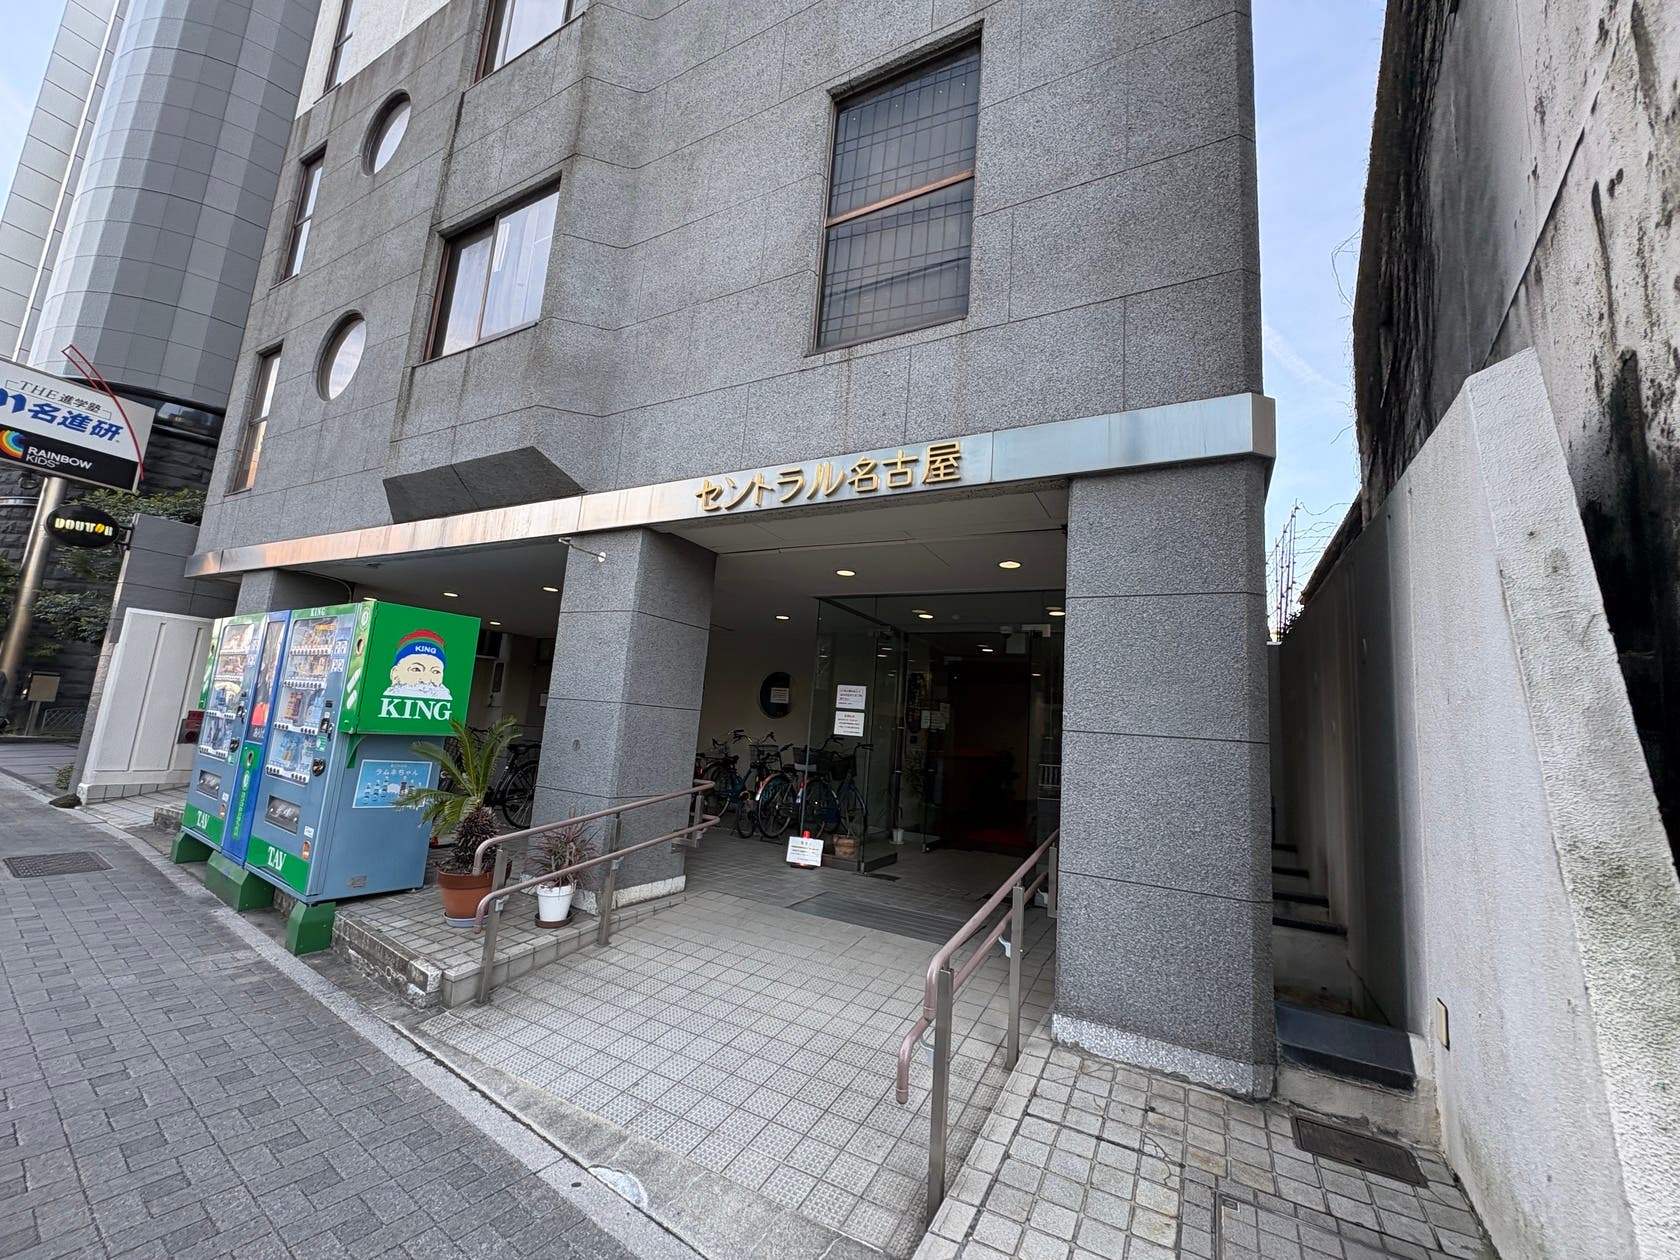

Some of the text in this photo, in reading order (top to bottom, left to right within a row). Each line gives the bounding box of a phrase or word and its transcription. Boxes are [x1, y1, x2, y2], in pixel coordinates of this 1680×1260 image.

[20, 380, 102, 413] THE 進学塾
[28, 402, 124, 441] 名進研
[26, 454, 58, 468] KIDS
[27, 446, 93, 469] RAINBOW
[695, 440, 961, 512] セントラル名古屋
[54, 517, 113, 536] DOUTOR
[310, 607, 326, 617] KING
[415, 645, 437, 654] KING
[377, 697, 452, 721] KING
